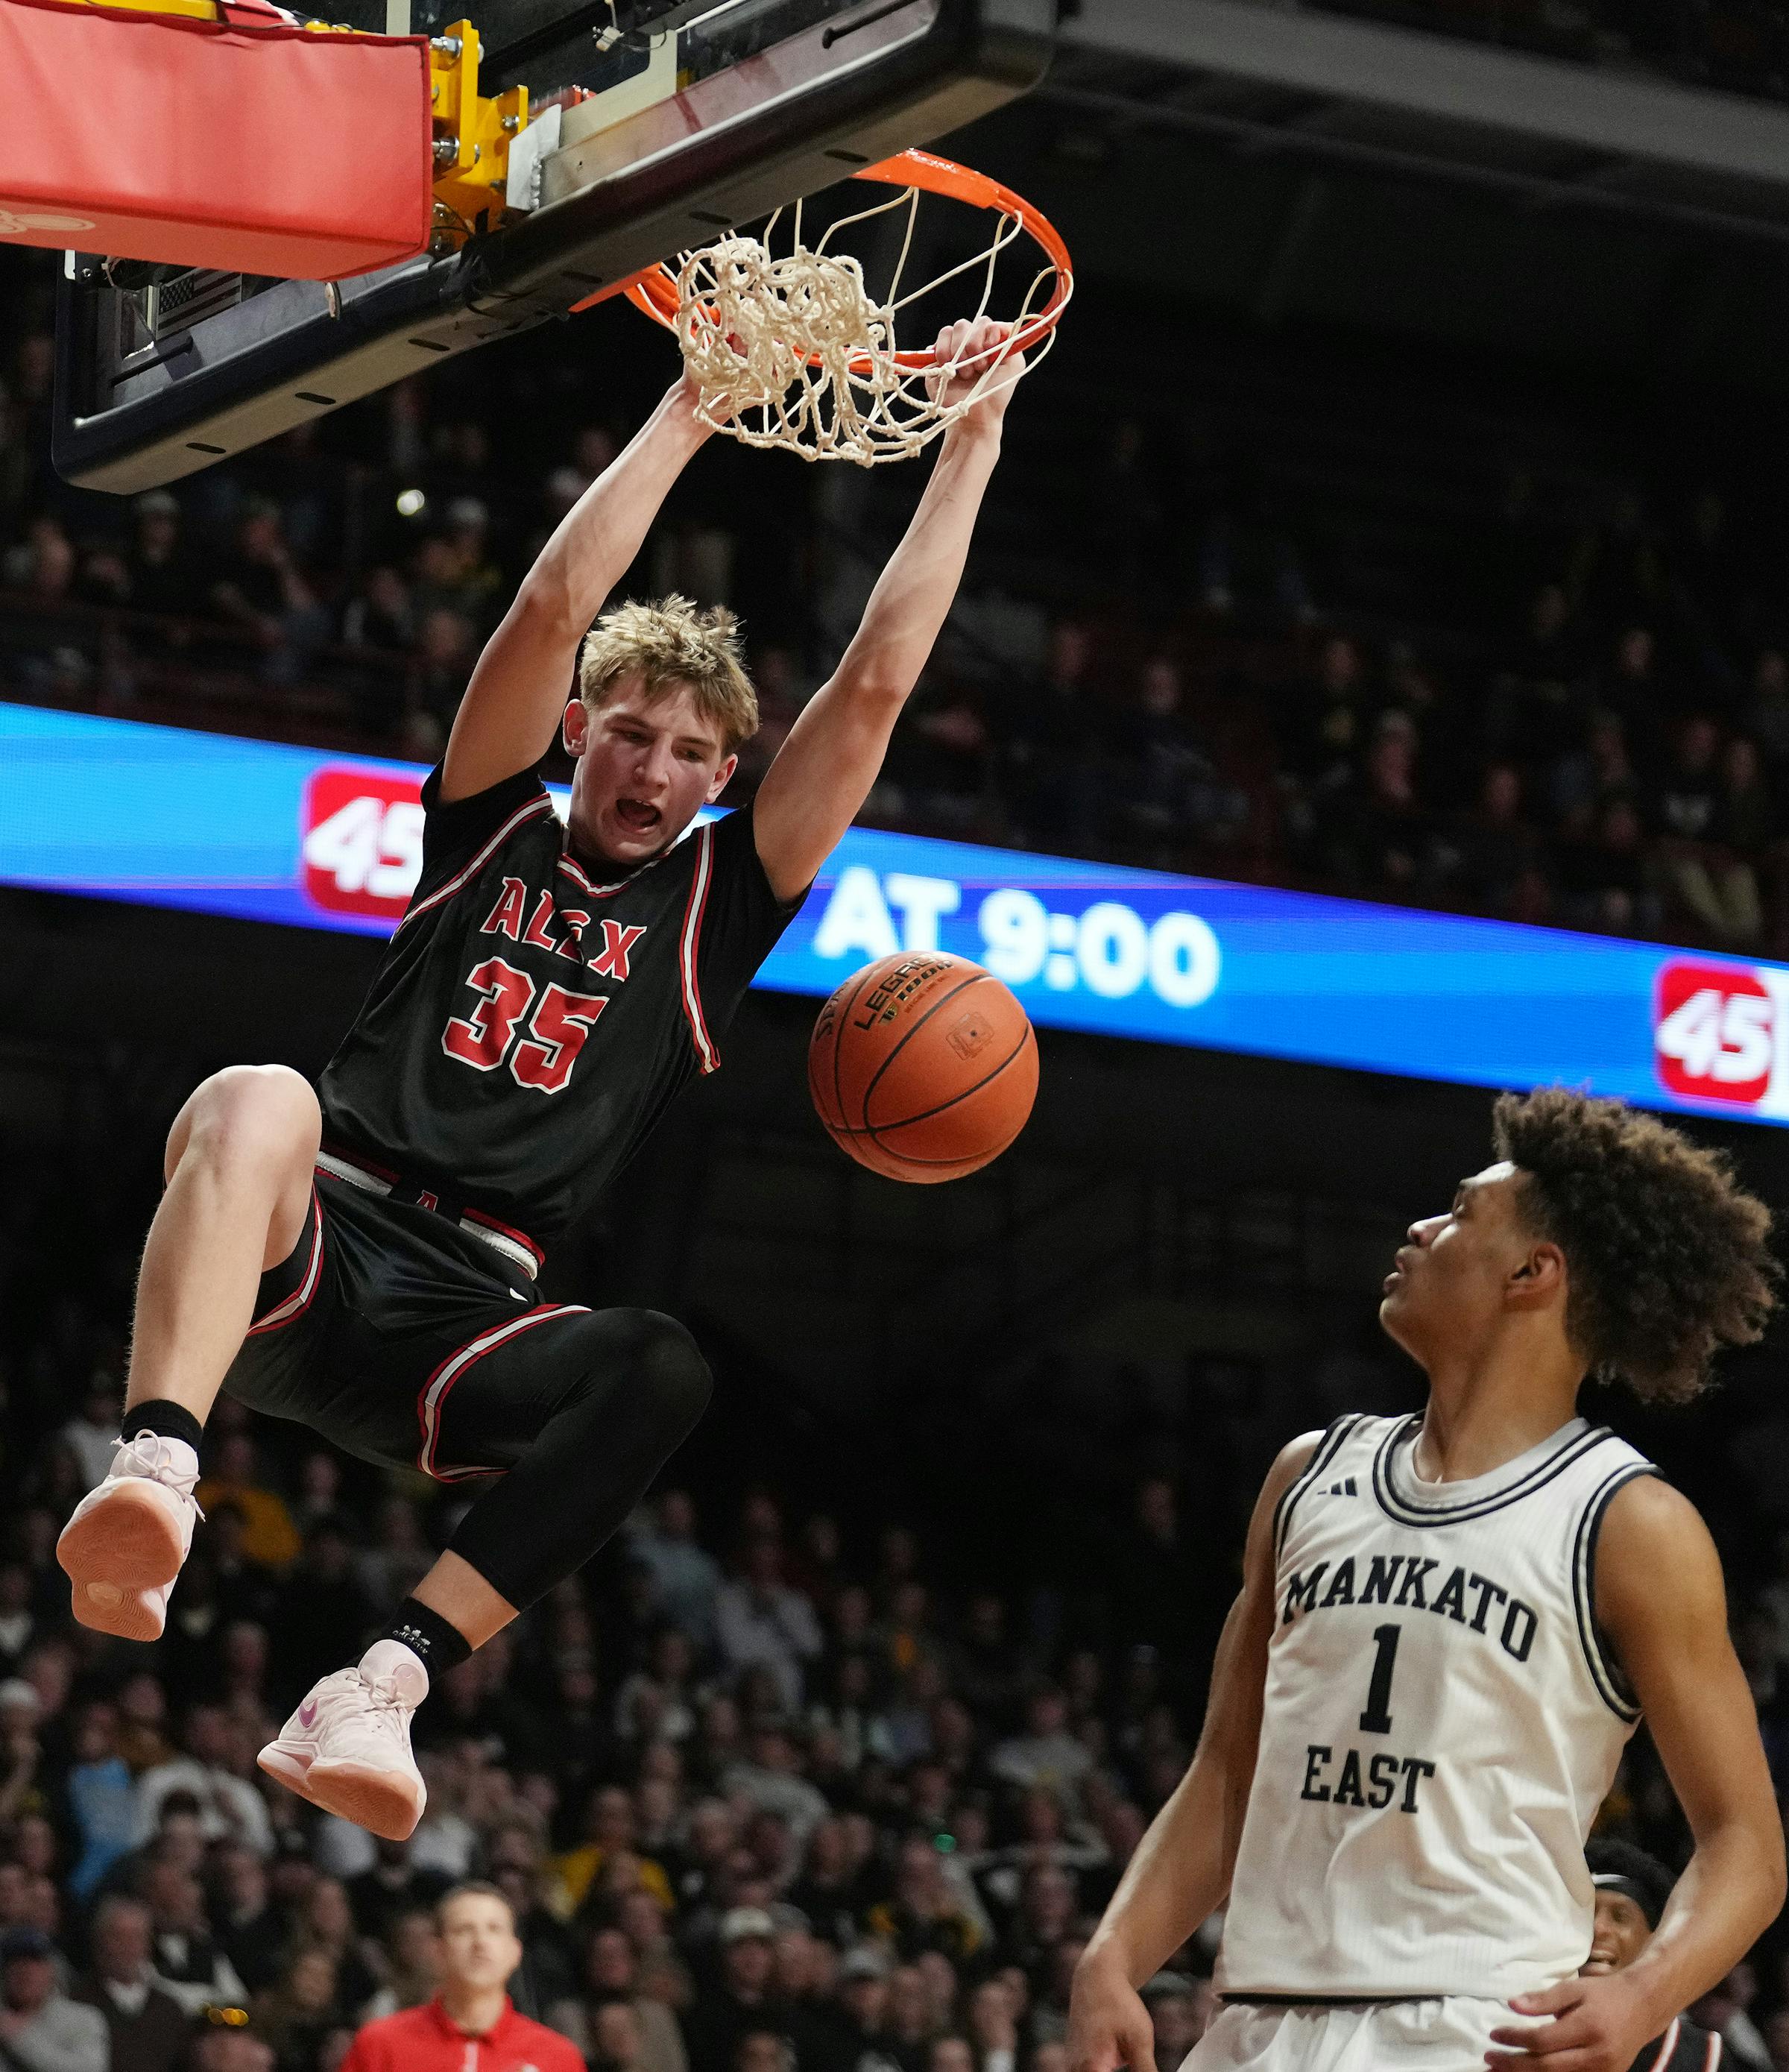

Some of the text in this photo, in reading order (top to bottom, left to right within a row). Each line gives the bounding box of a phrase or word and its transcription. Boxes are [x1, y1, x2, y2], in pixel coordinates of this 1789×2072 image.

[303, 796, 426, 899] 45
[813, 863, 1222, 1008] AT 9:00
[441, 956, 610, 1095] 35
[1655, 988, 1772, 1083] 45
[1282, 1555, 1539, 1663] MANKATO
[1359, 1622, 1401, 1734] 1
[1301, 1745, 1436, 1813] EAST
